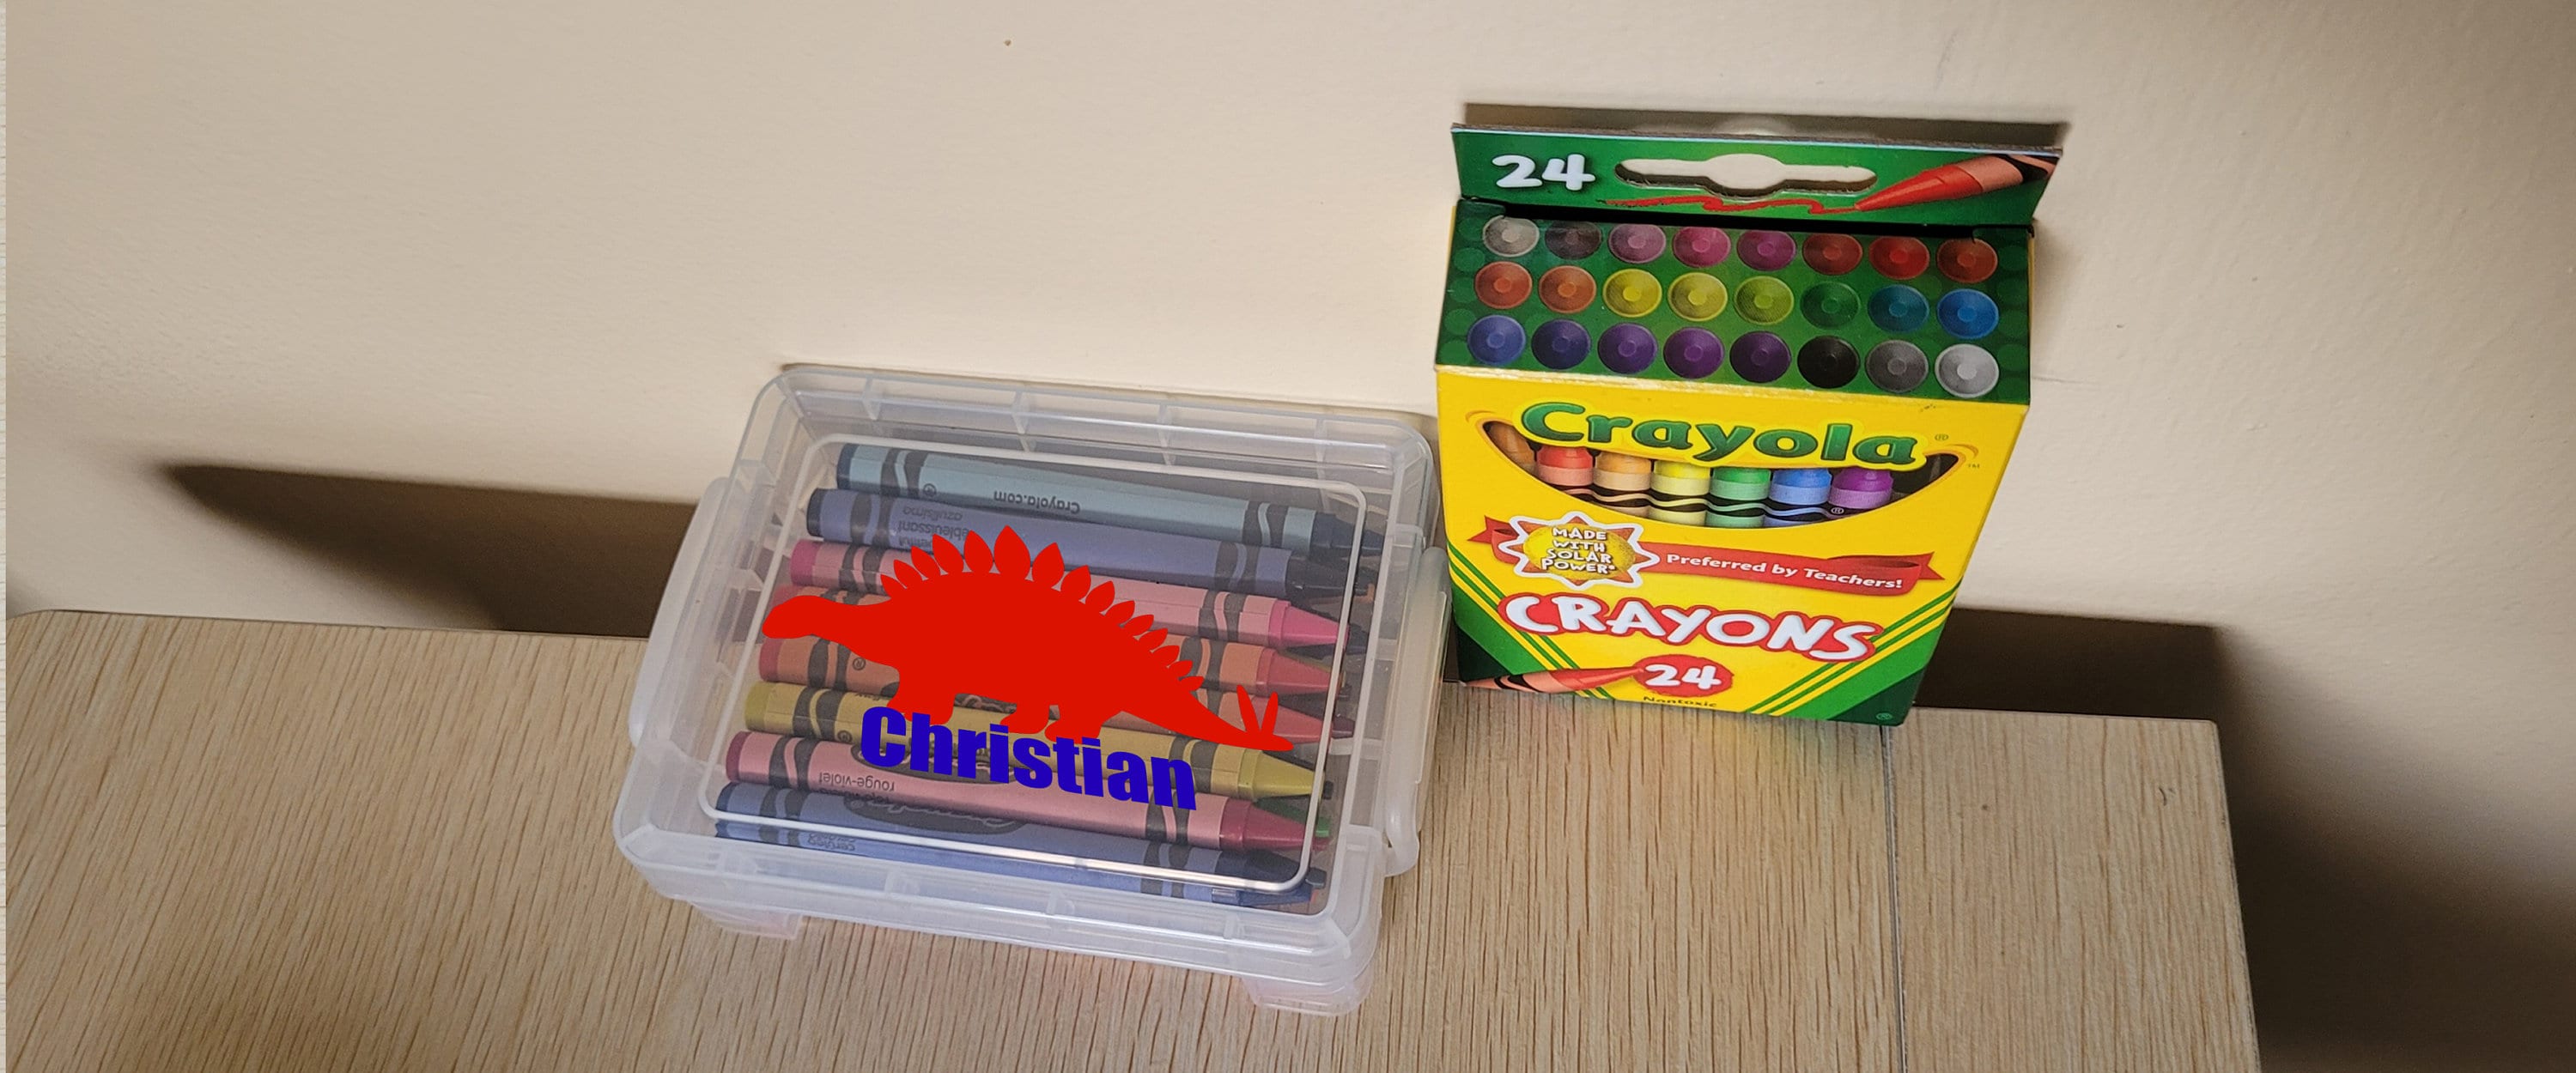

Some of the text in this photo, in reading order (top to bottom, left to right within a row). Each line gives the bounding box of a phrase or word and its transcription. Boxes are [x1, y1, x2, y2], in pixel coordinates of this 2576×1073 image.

[1492, 154, 1595, 191] 24
[1521, 402, 1918, 467] Crayola
[993, 490, 1080, 514] Crayola.com
[1552, 527, 1607, 540] MADE
[1546, 549, 1612, 563] SOLAR
[1552, 540, 1605, 552] WITH
[1667, 554, 1903, 589] Preferred by Teachers!
[1504, 594, 1876, 659] CRAYONS
[1645, 664, 1722, 690] 24
[1643, 696, 1717, 707] Nontoxic
[818, 772, 896, 792] rouge-violet
